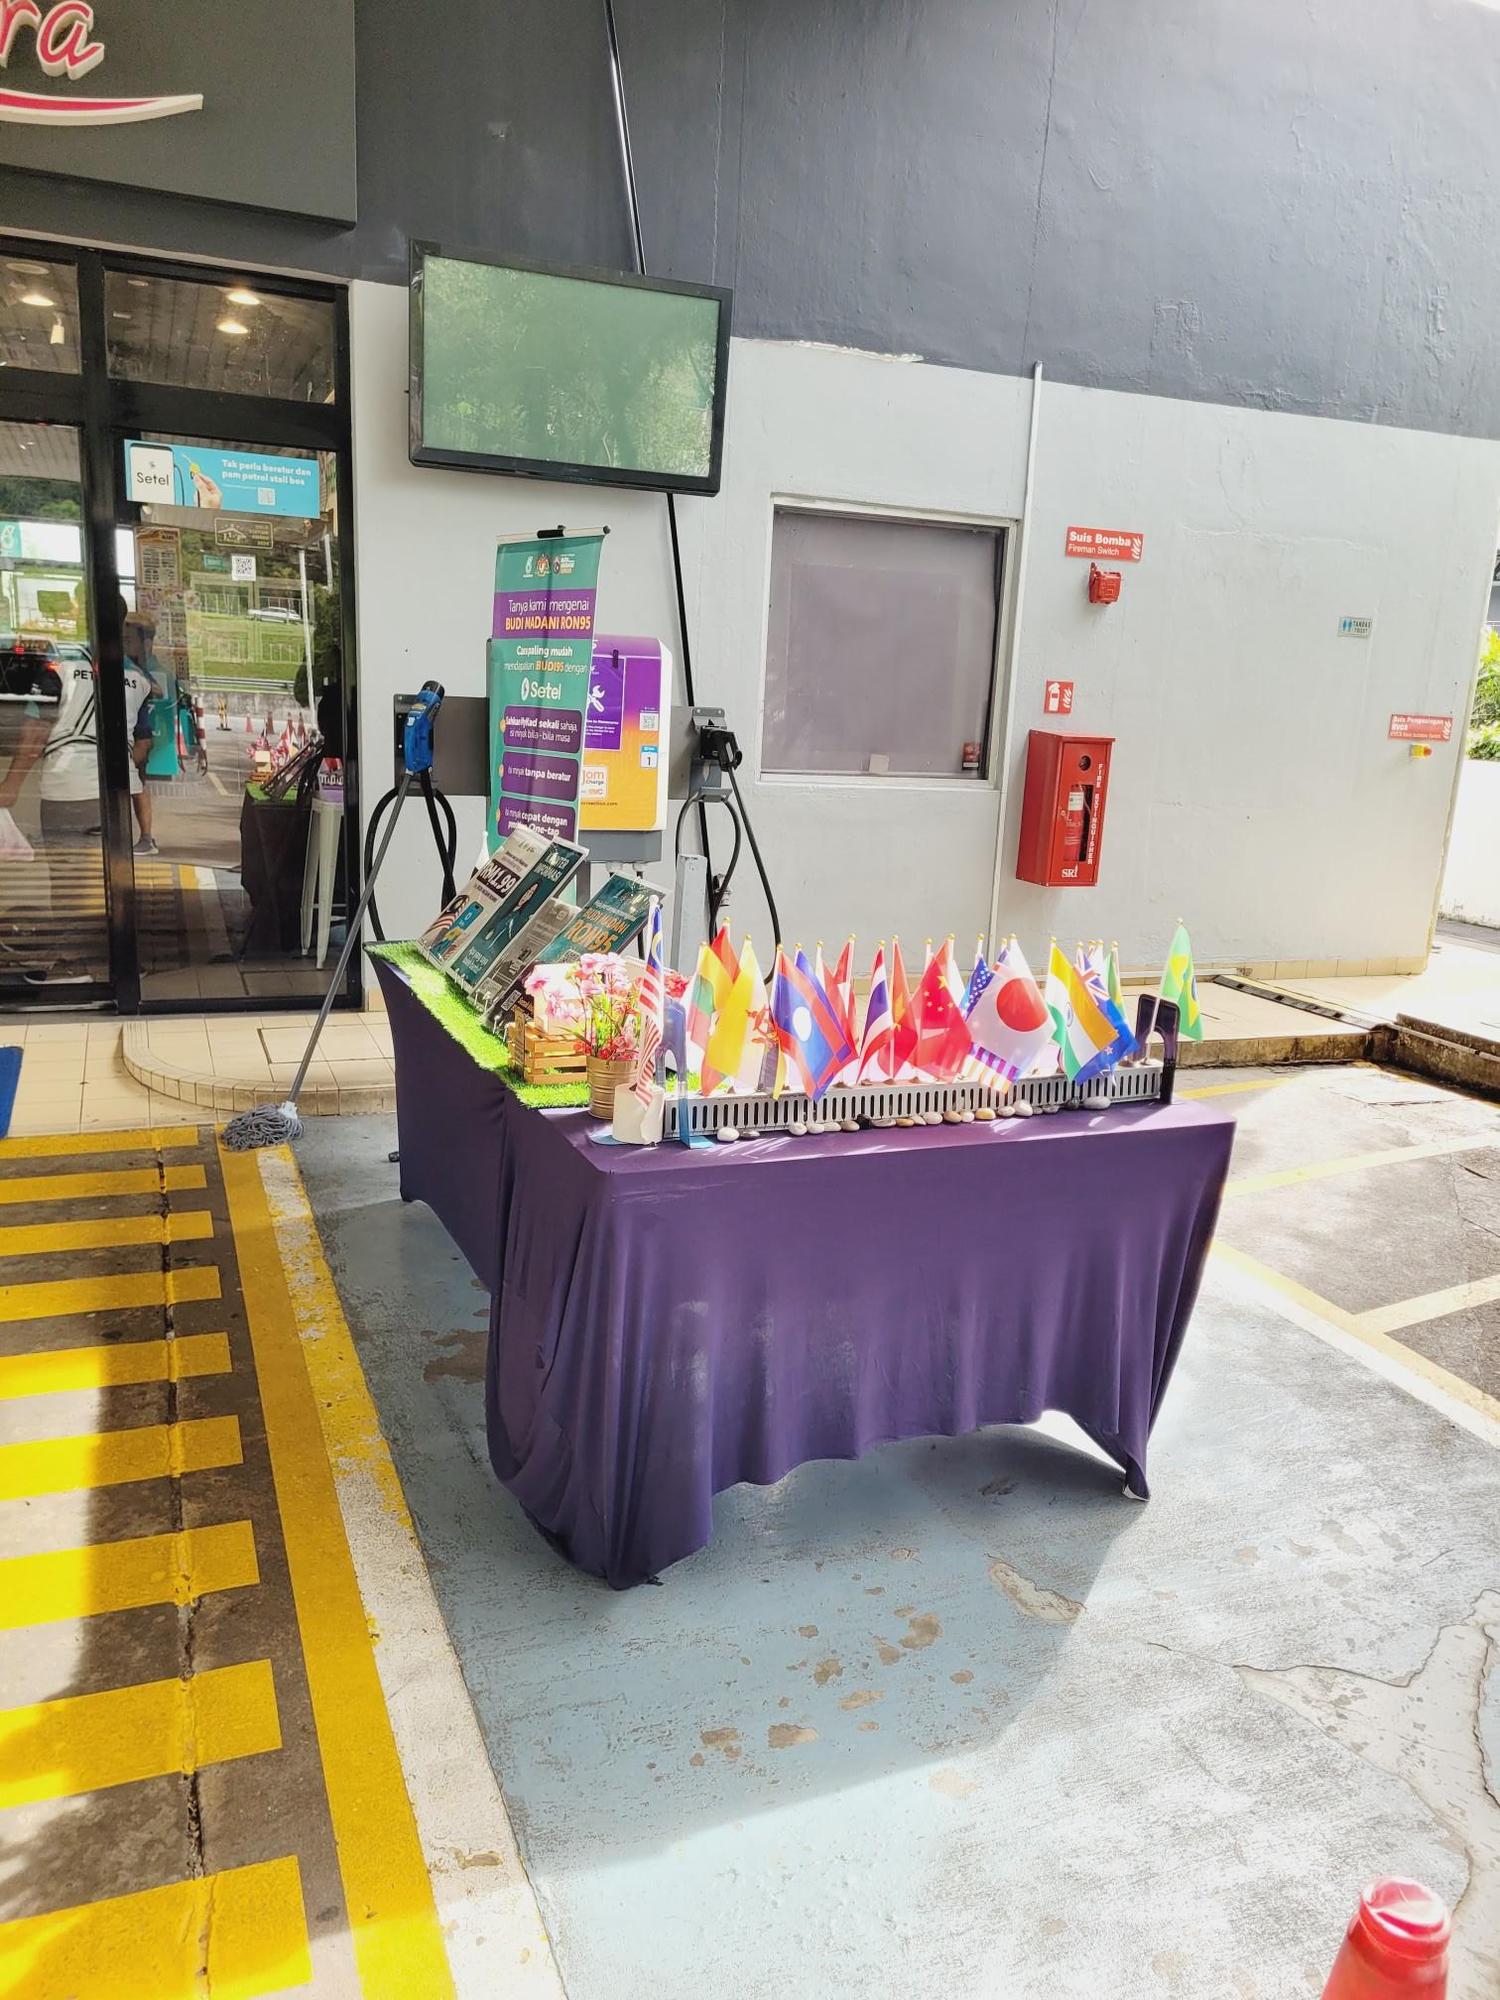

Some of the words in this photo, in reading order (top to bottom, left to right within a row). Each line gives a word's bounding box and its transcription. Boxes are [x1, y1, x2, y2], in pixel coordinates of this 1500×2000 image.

[222, 471, 241, 480] pam
[262, 464, 294, 474] beratur
[295, 468, 312, 477] dan
[136, 471, 169, 487] Setel
[1069, 531, 1093, 543] Suis
[1095, 533, 1131, 547] Bomba
[1068, 543, 1096, 554] Fireman
[1097, 546, 1120, 556] Switch
[508, 599, 529, 616] Tanya
[528, 598, 547, 611] kami
[549, 597, 590, 615] mengenai
[505, 617, 524, 630] BUDI
[560, 615, 592, 630] RON95
[530, 681, 561, 701] Setel
[538, 719, 560, 730] sekali
[525, 768, 546, 780] tanpa
[1095, 763, 1104, 789] FIRE
[521, 811, 541, 822] cepat
[541, 813, 568, 827] dengan
[1087, 793, 1100, 865] EXTINGUISHER
[562, 918, 619, 954] RON95
